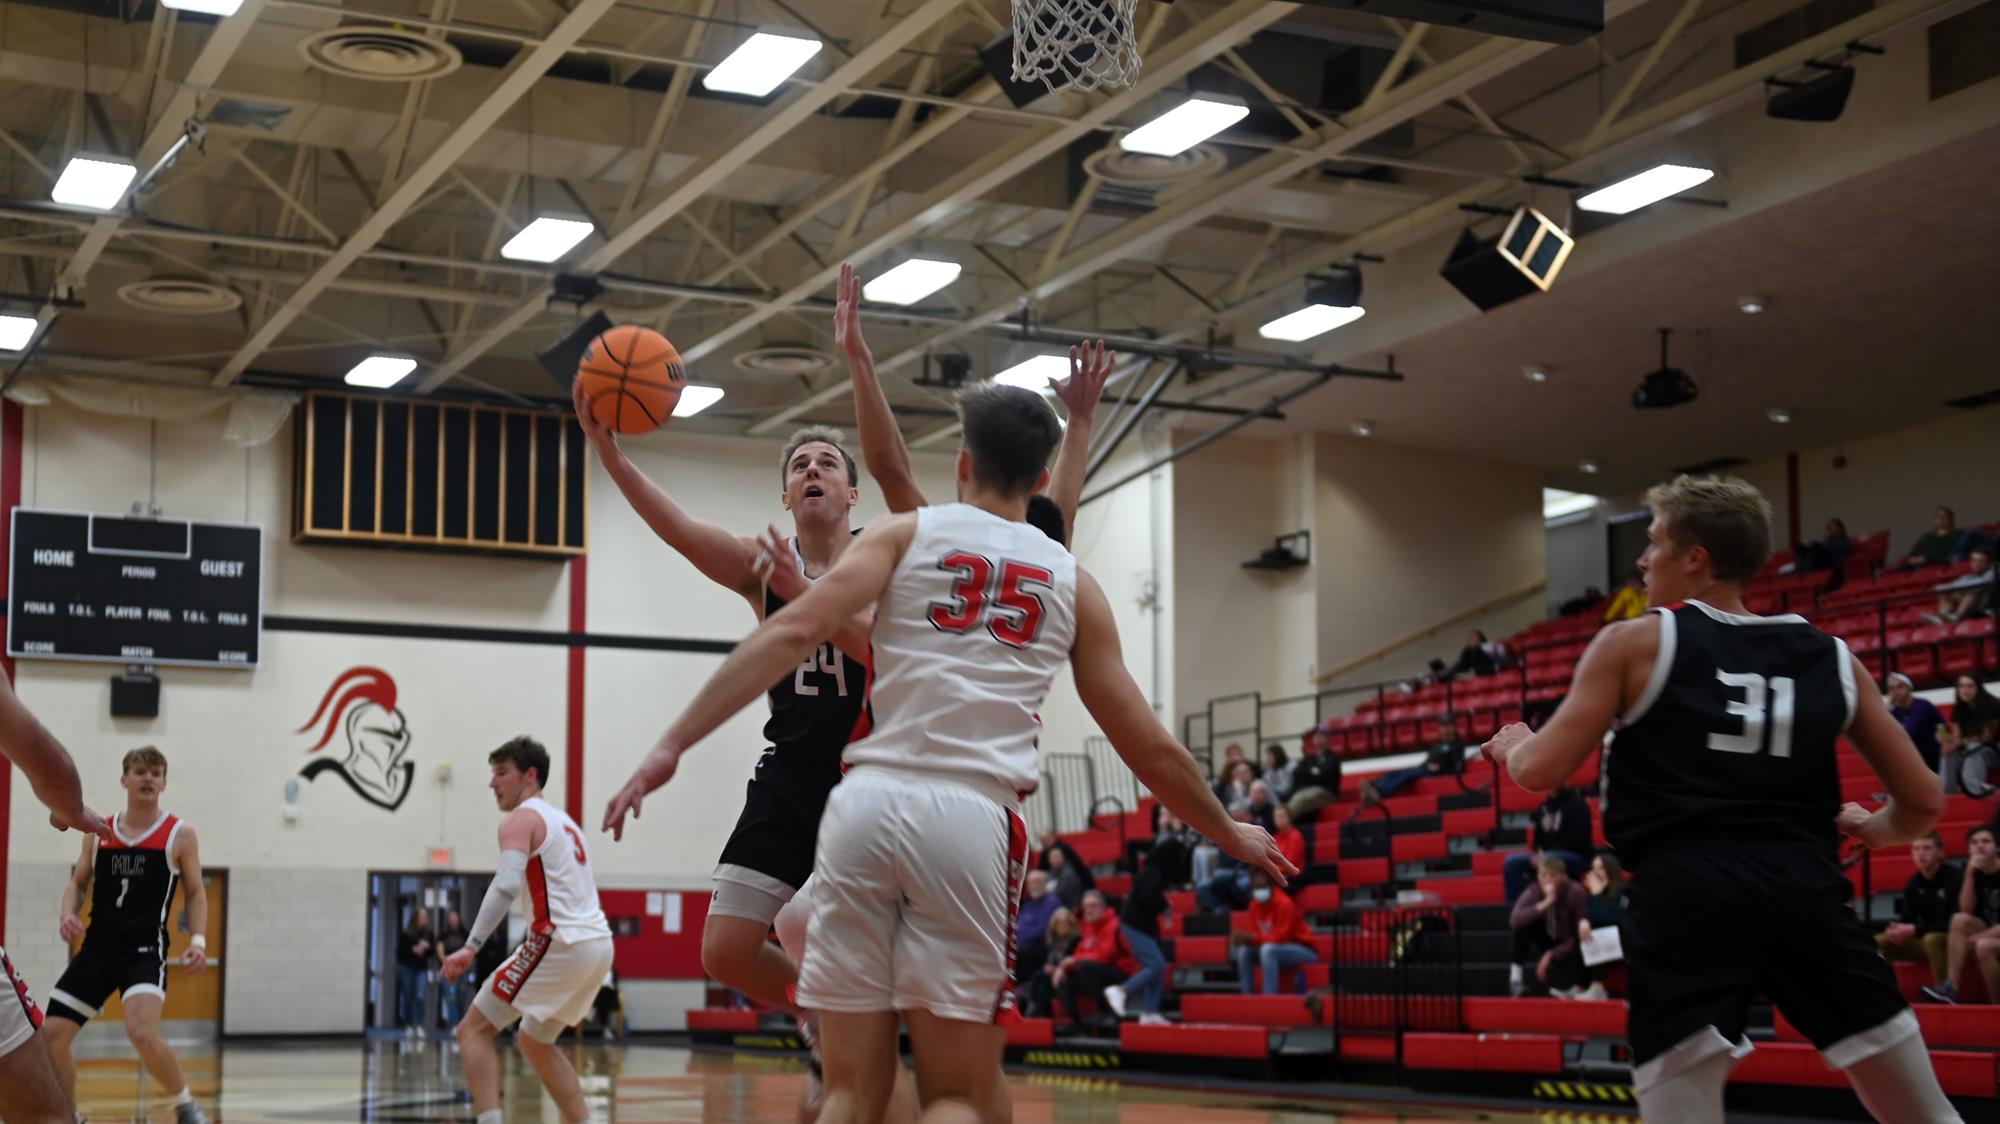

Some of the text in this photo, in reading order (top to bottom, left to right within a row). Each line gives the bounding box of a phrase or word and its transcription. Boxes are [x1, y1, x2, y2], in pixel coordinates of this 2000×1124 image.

[33, 549, 75, 567] HOME
[121, 565, 156, 579] PERIOD
[200, 559, 244, 578] GUEST
[23, 601, 55, 615] FOULS
[926, 549, 1055, 650] 35
[105, 605, 171, 621] PLAYER FOUL
[218, 612, 248, 626] FOULS
[23, 641, 55, 654] SCORE
[121, 645, 153, 658] MATCH
[794, 644, 848, 697] 24
[1706, 666, 1795, 758] 31
[563, 823, 587, 867] 3
[111, 853, 146, 877] MLC
[115, 878, 129, 908] 1
